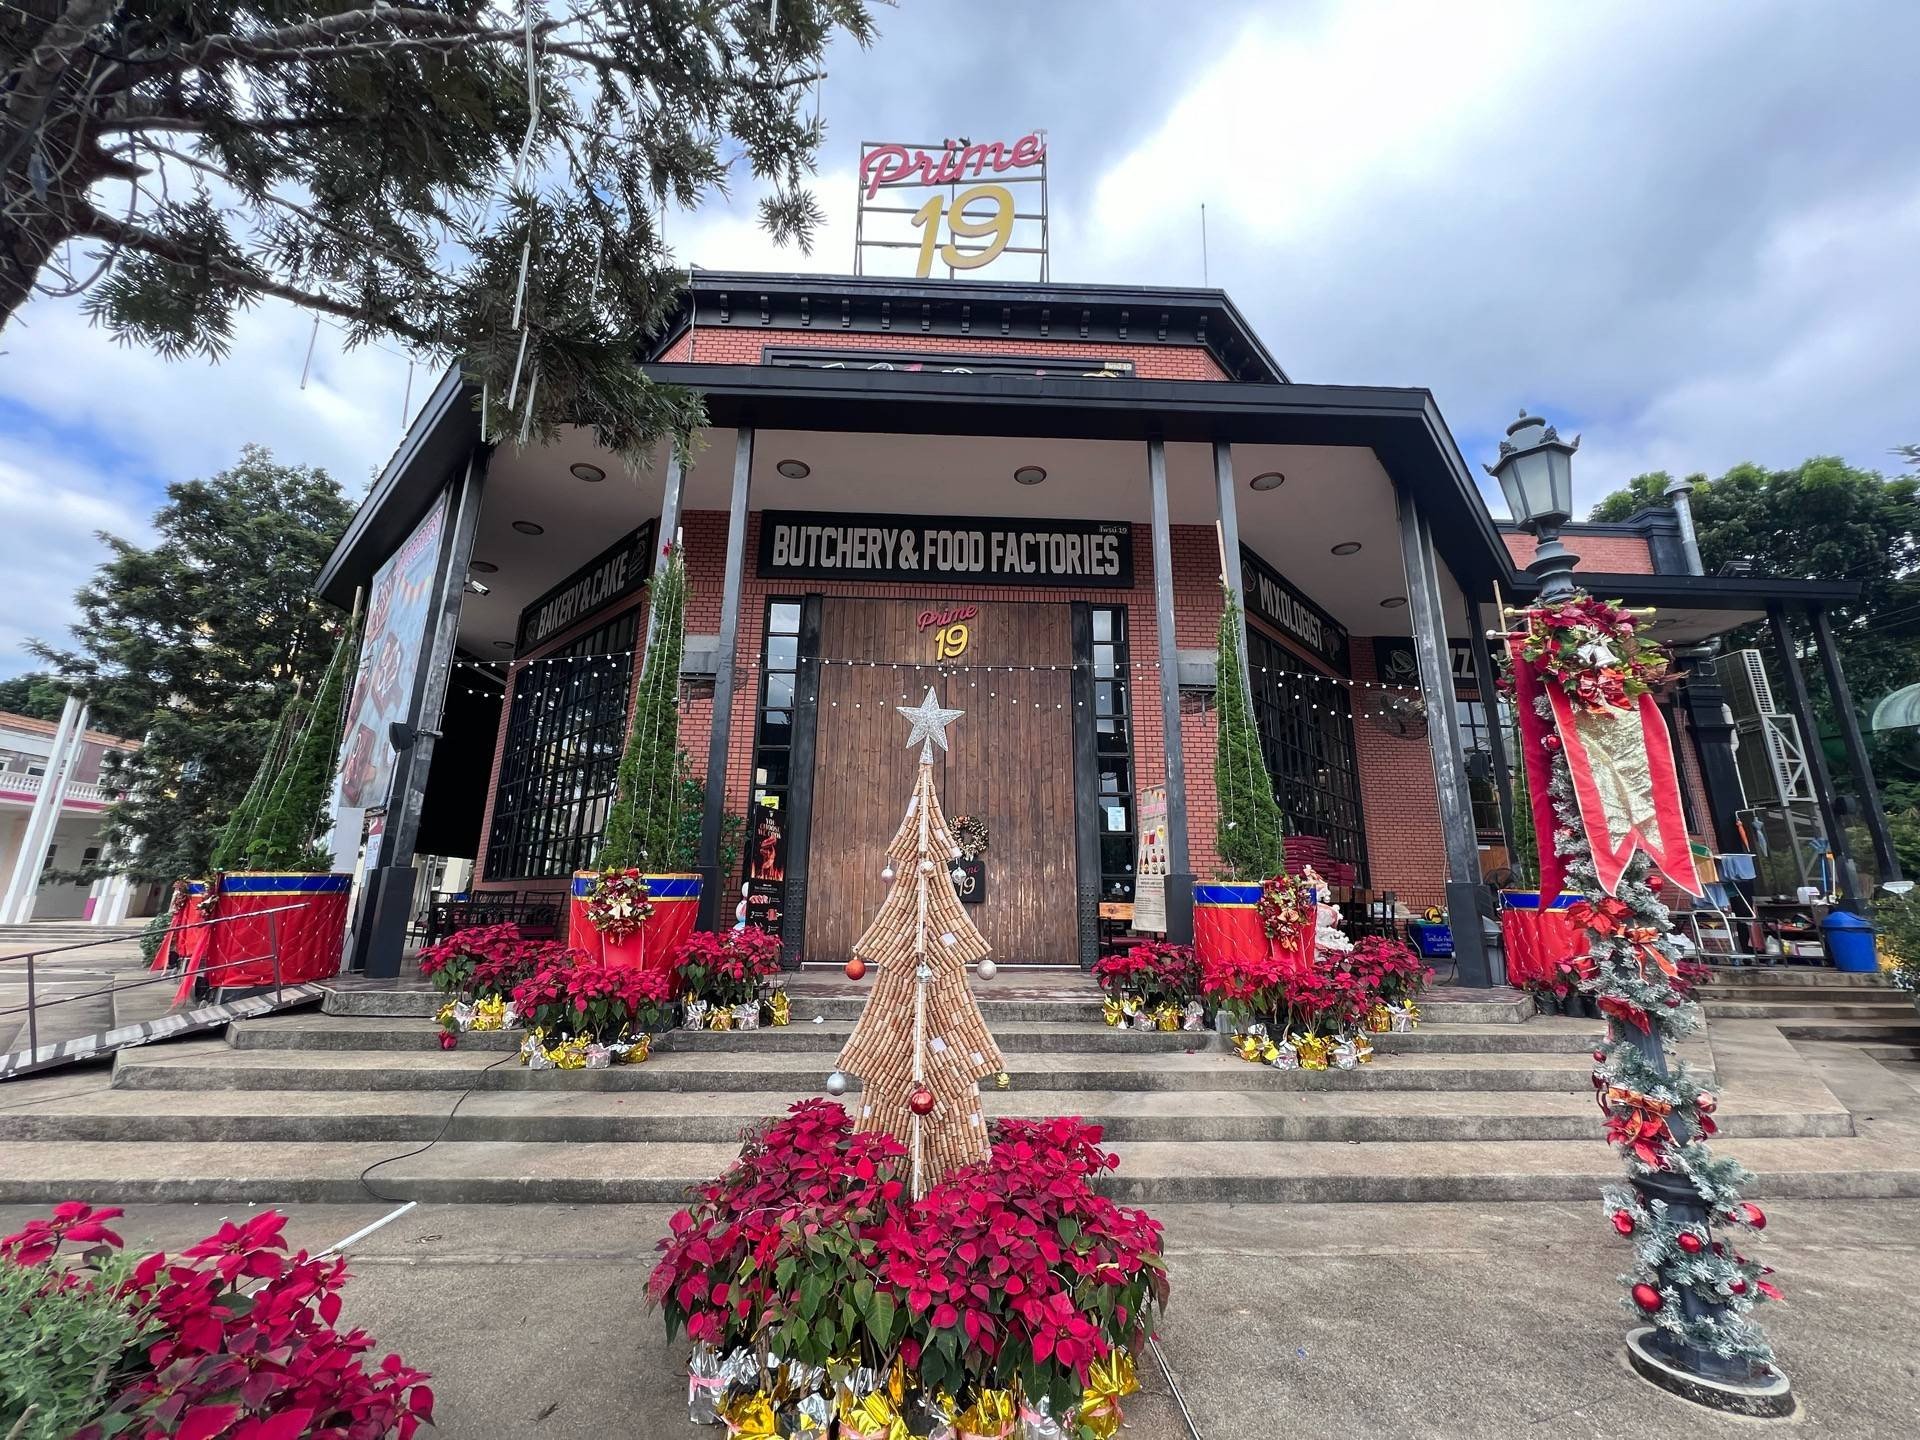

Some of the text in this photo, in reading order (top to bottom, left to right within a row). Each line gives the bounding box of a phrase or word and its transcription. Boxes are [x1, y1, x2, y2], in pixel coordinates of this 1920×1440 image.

[860, 135, 1047, 200] Prime
[911, 185, 1015, 278] 19
[923, 530, 984, 572] FOOD
[991, 532, 1119, 576] FACTORIES
[917, 604, 978, 632] Prime
[1259, 572, 1323, 651] MIXOLOGIST
[935, 624, 968, 661] 19
[1449, 648, 1475, 678] ZZ
